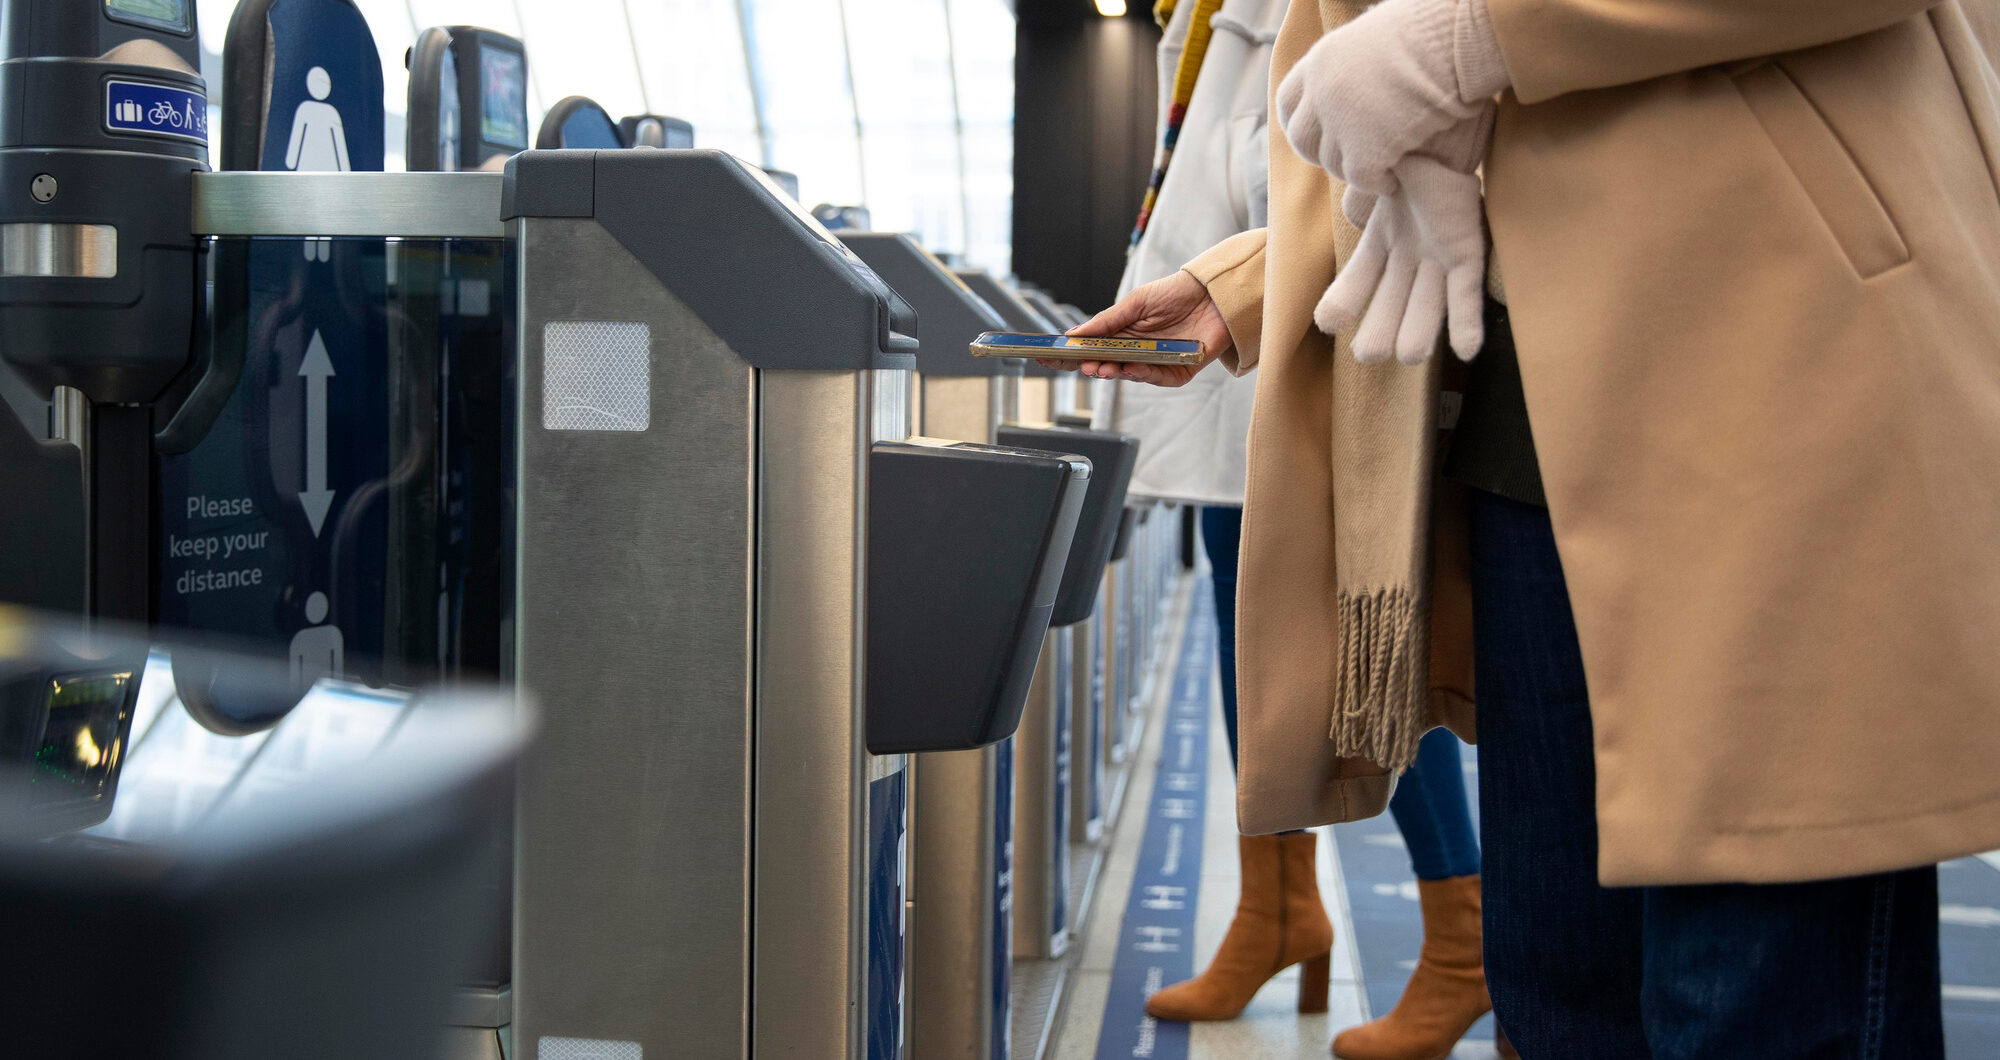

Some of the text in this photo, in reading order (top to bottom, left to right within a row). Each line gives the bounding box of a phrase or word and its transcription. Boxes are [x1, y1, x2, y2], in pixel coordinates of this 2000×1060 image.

[187, 495, 253, 519] Please
[170, 531, 269, 560] keep your
[177, 567, 262, 594] distance
